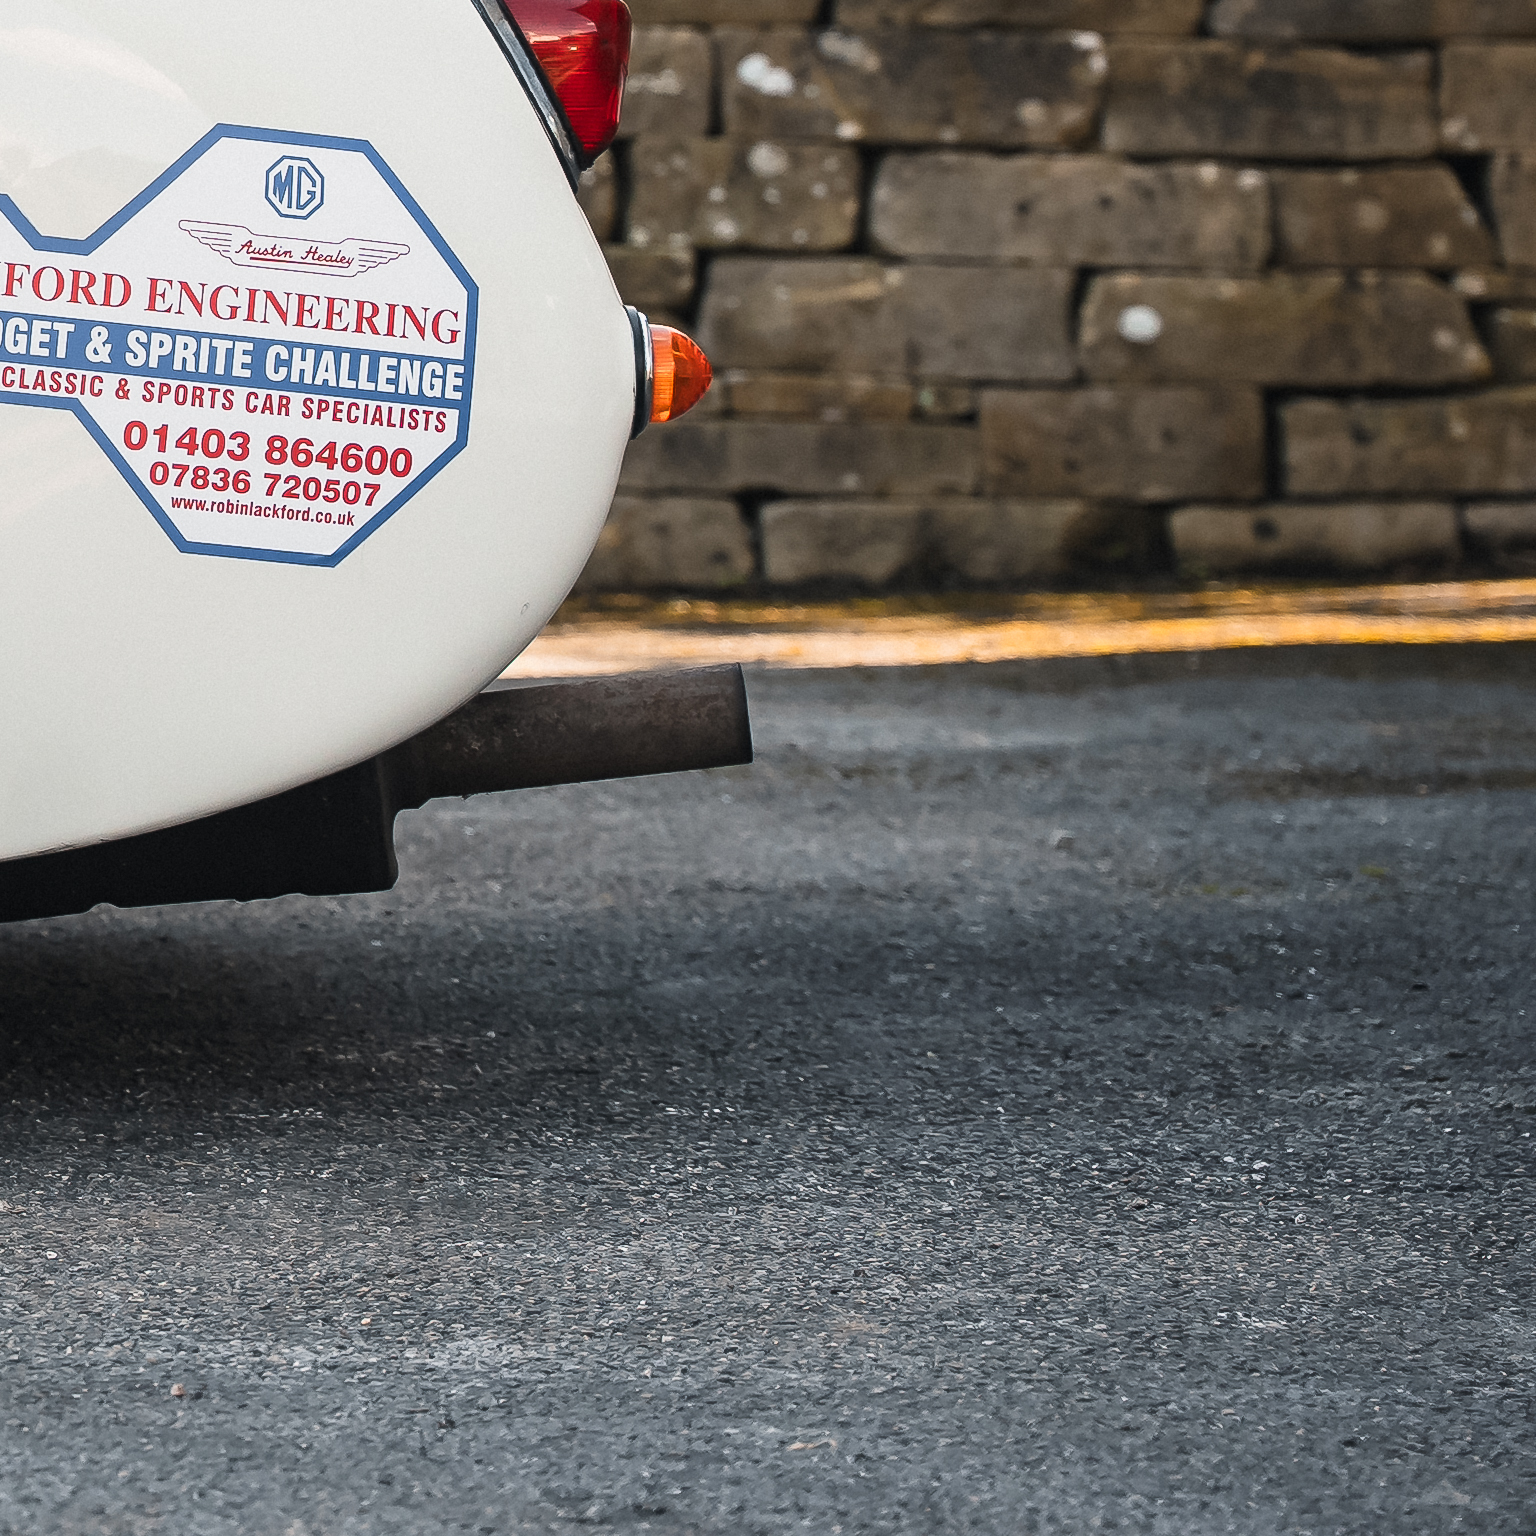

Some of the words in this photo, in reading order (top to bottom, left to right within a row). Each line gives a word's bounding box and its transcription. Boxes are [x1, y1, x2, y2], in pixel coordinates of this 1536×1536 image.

[272, 165, 317, 210] MG
[235, 239, 293, 259] Austin
[300, 245, 355, 266] Healey
[147, 276, 461, 346] ENGINEERING
[86, 325, 112, 363] &
[125, 328, 262, 378] SPRITE
[265, 344, 465, 401] CHALLENGE
[1, 365, 104, 398] CLASSIC
[114, 377, 131, 402] &
[141, 380, 235, 410] SPORTS
[244, 391, 290, 418] CAR
[301, 397, 447, 434] SPECIALISTS
[123, 420, 251, 462] 01403
[264, 434, 413, 478] 864600
[149, 461, 252, 494] 07836
[263, 473, 381, 507] 720507
[170, 494, 355, 527] www.robinlackford.co.uk
